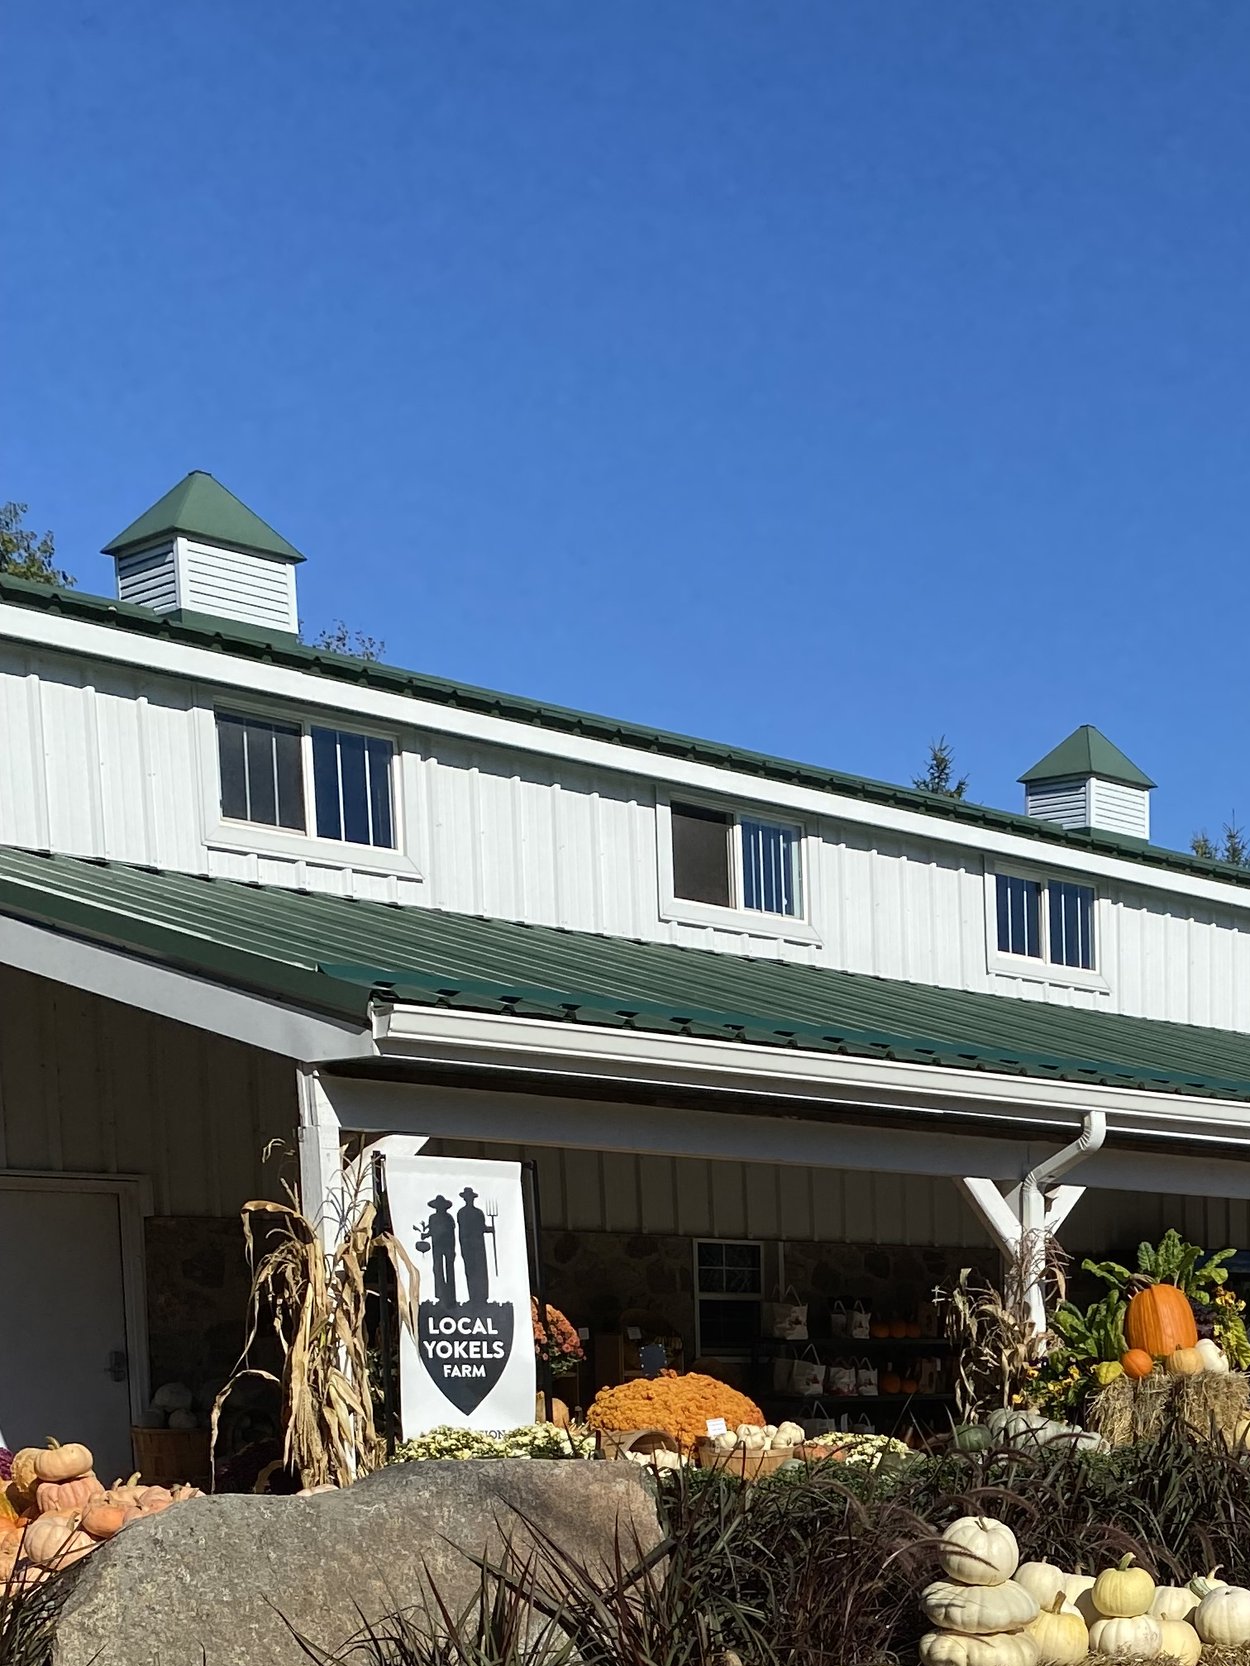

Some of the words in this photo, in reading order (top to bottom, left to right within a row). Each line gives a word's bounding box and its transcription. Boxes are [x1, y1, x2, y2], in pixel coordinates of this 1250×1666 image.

[428, 1317, 498, 1335] LOCAL
[422, 1340, 505, 1359] YOKELS
[443, 1364, 486, 1378] FARM
